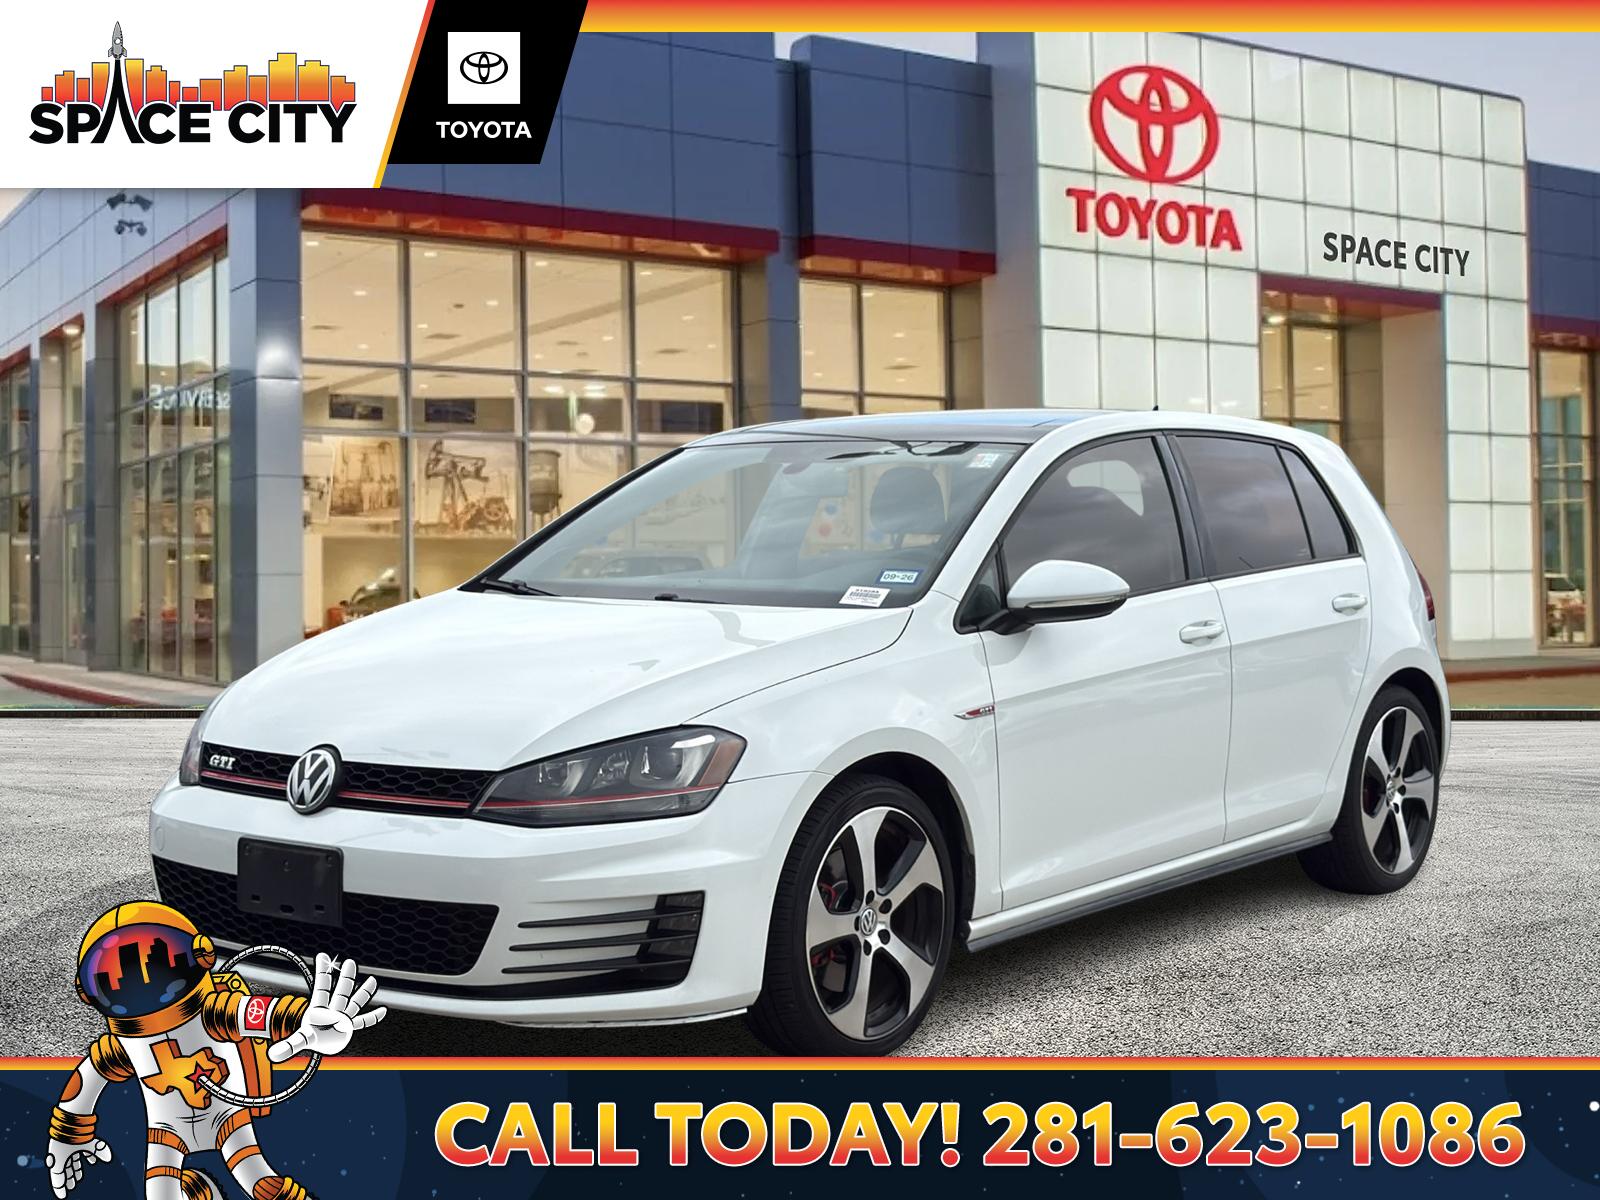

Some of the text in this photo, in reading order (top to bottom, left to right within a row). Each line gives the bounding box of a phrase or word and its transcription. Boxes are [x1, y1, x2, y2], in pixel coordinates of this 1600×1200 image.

[1066, 187, 1242, 251] TOYOTA
[1323, 231, 1470, 277] SPACE CITY
[883, 573, 914, 581] 09-26
[209, 754, 236, 770] GTI
